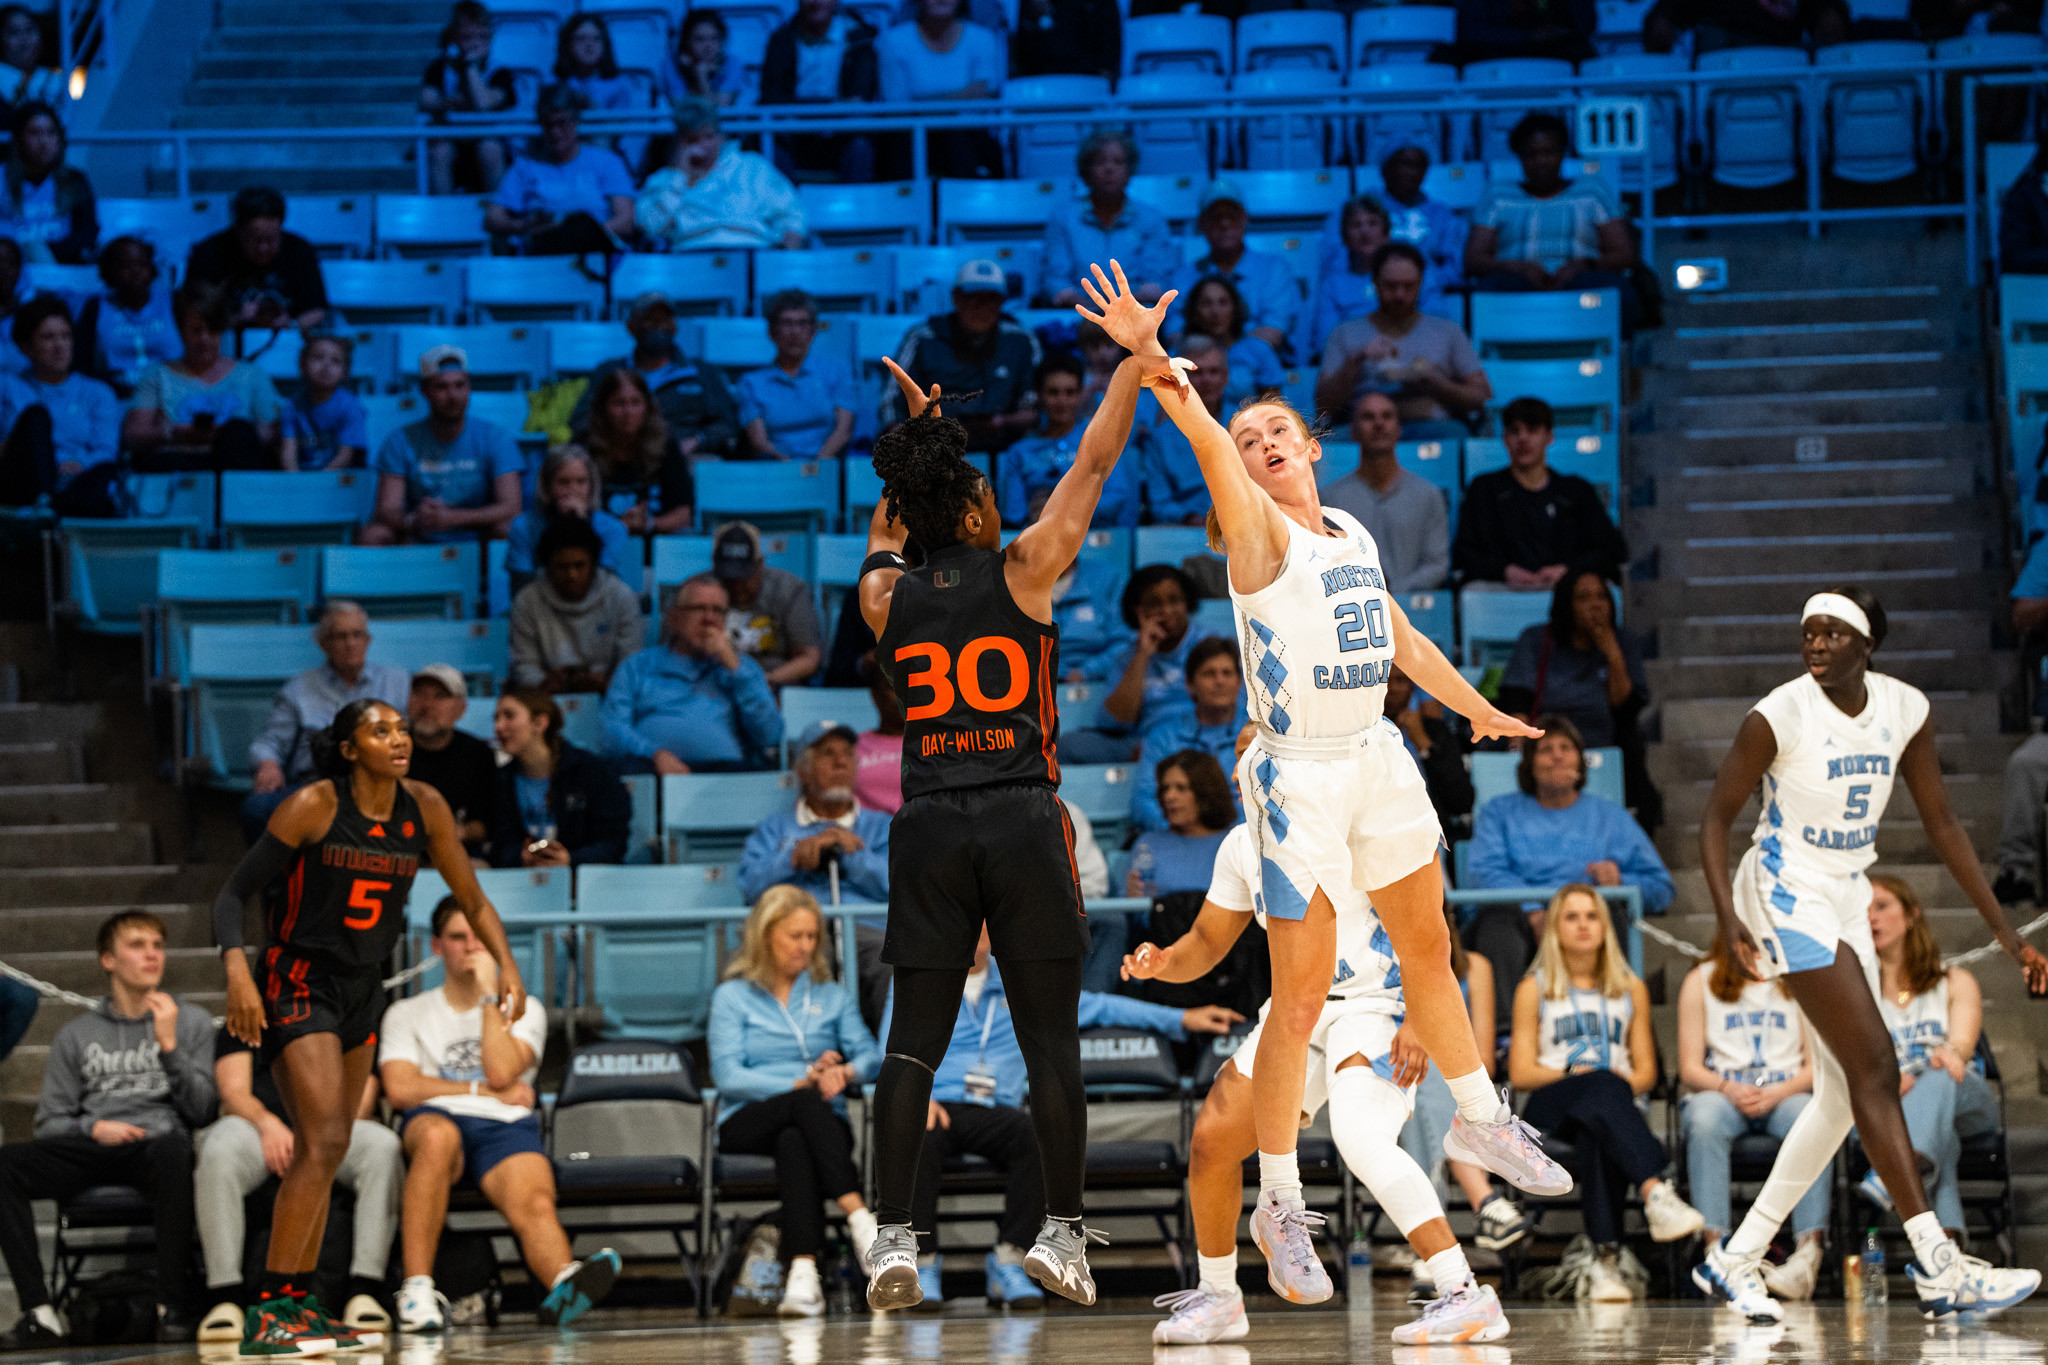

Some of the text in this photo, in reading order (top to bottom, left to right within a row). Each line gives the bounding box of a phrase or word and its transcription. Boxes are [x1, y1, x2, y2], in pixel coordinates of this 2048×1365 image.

[1587, 110, 1635, 144] 111
[1321, 565, 1386, 598] NORTH
[1334, 599, 1389, 653] 20
[895, 636, 1030, 721] 30
[1313, 658, 1394, 690] CAROLI
[922, 728, 1015, 757] DAY-WILSON
[1827, 753, 1891, 781] NORTH
[1843, 784, 1872, 820] 5
[343, 878, 393, 931] 5
[573, 1052, 683, 1076] CAROLINA
[1079, 1036, 1160, 1061] ROLINA
[878, 1256, 895, 1270] FEAR
